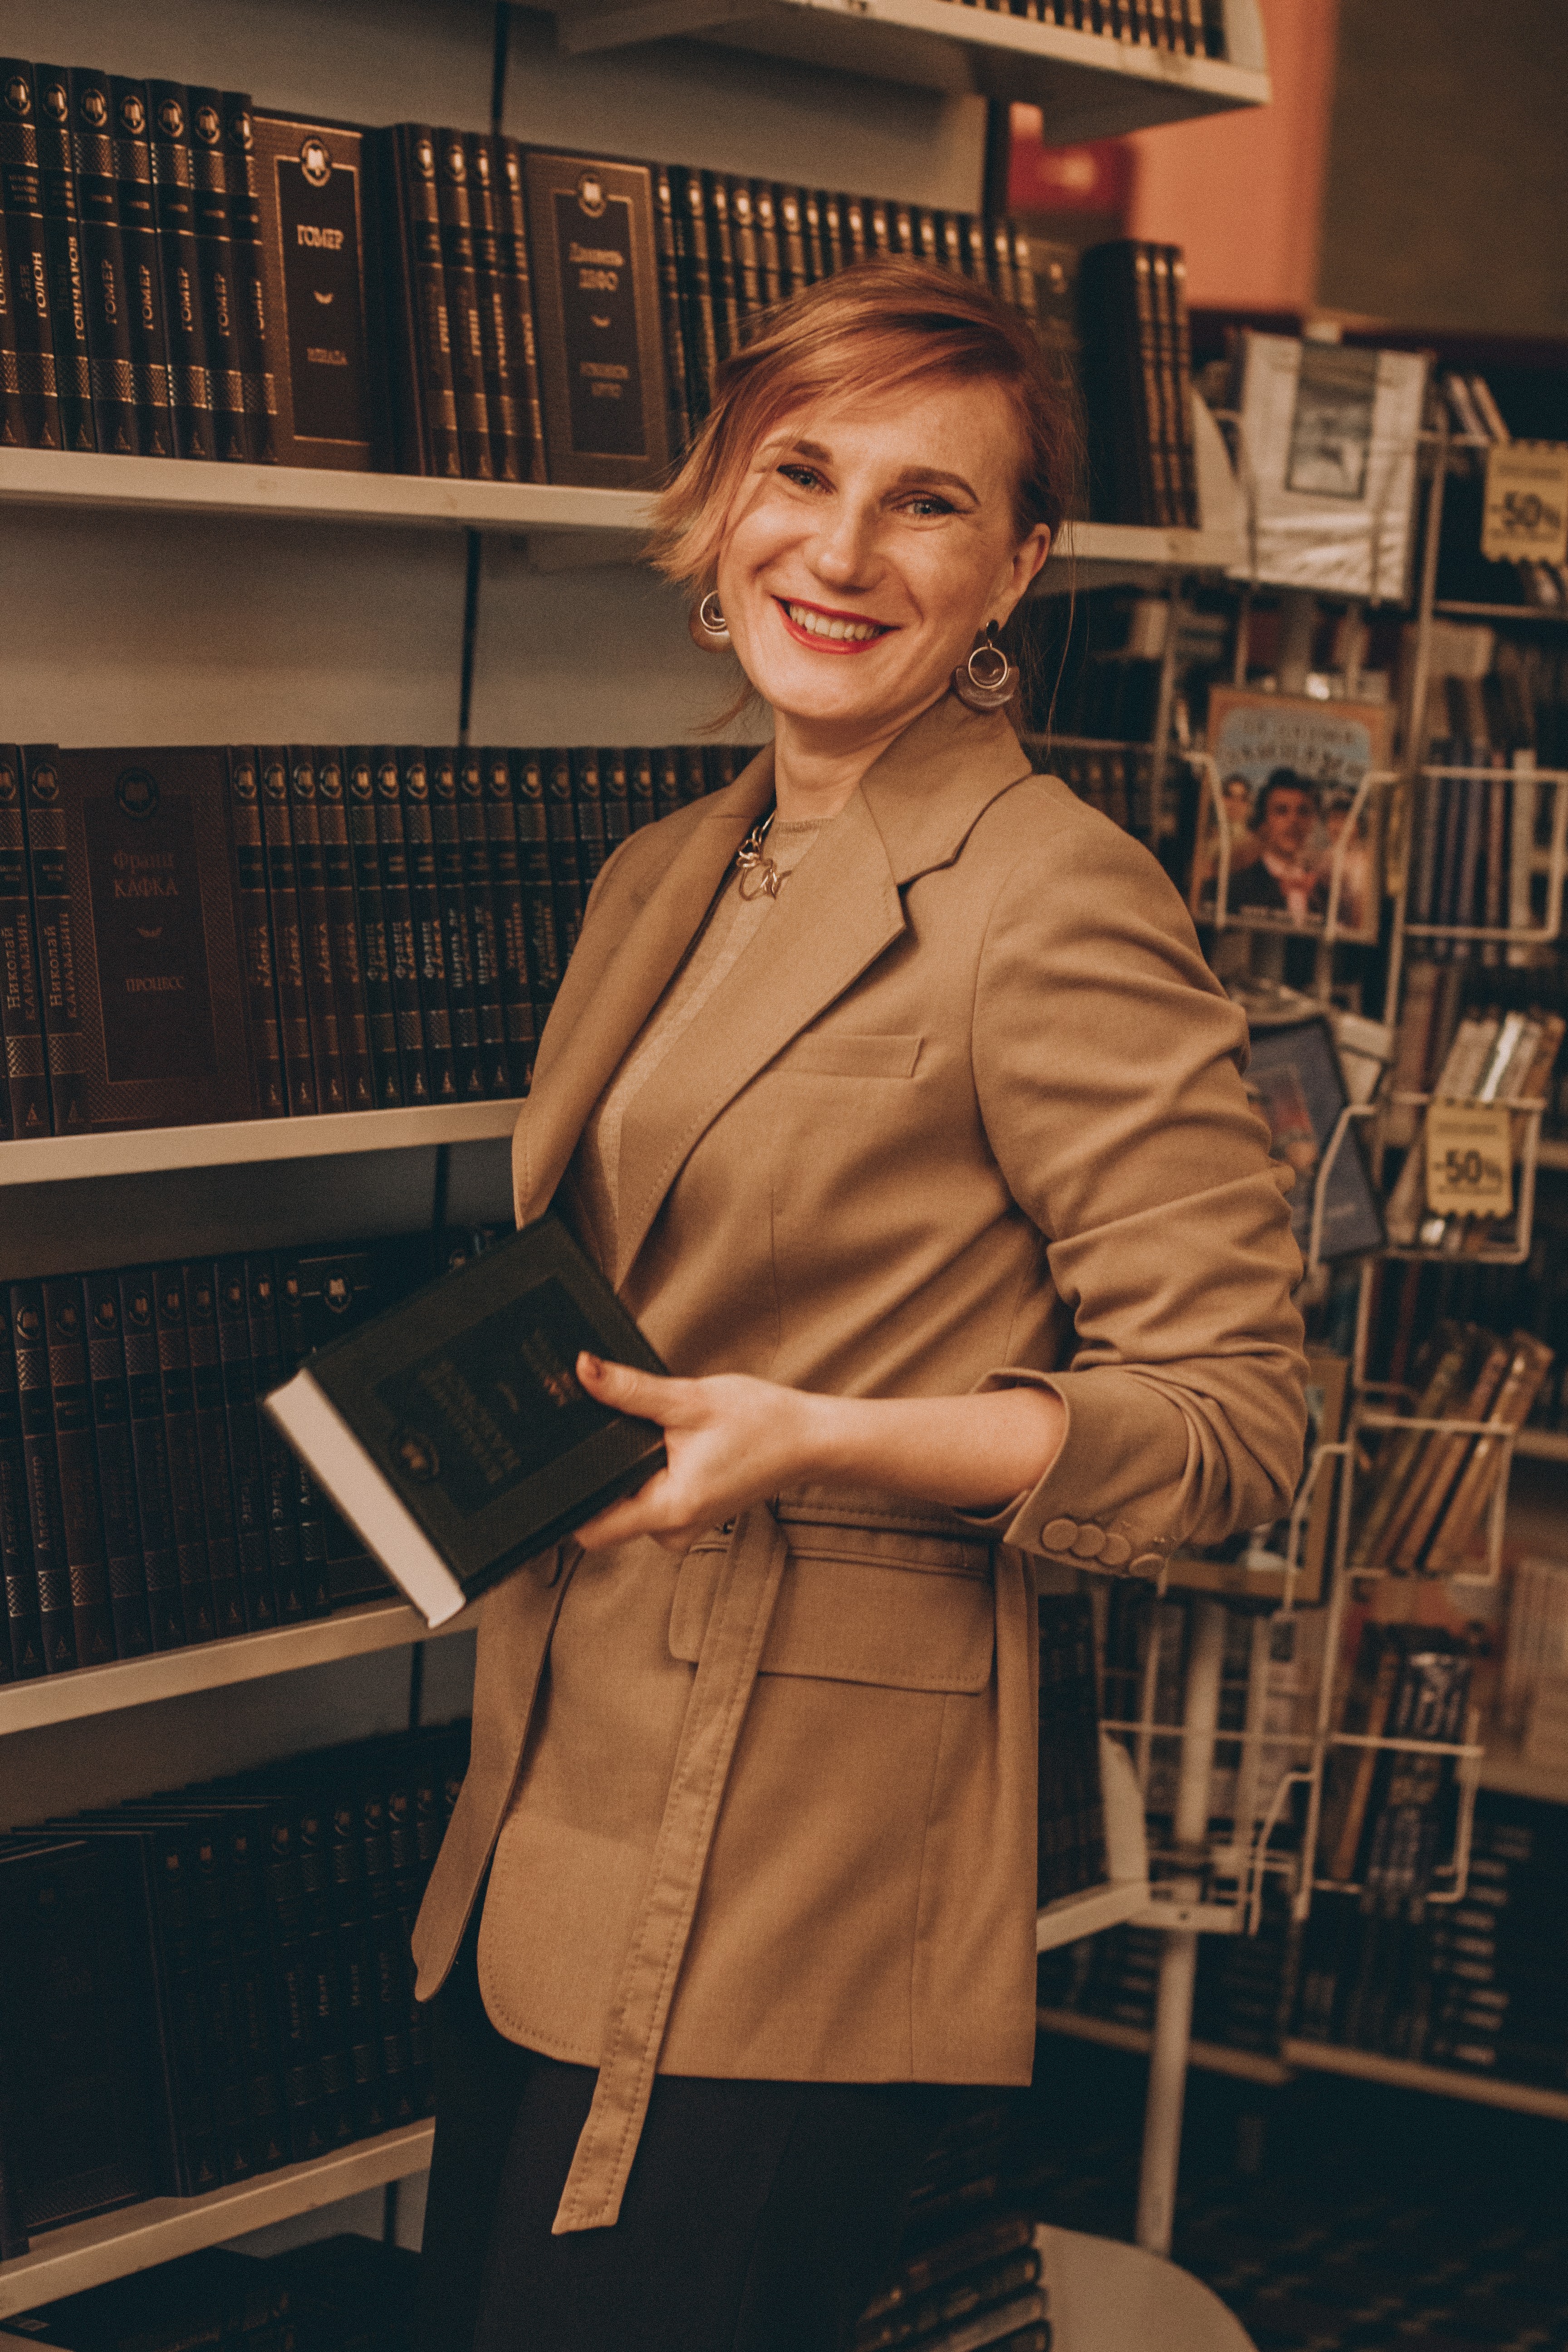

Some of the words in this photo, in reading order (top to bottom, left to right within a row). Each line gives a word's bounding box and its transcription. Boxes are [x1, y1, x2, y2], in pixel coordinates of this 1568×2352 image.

[297, 224, 343, 250] ГОМЕР
[31, 251, 47, 319] ГОЛОН
[68, 235, 86, 341] ГОНЧАРОВ
[101, 259, 118, 325] ГОМЕР
[139, 264, 154, 331] ГОМЕР
[177, 266, 193, 333] ГОМЕР
[214, 272, 230, 338] ГОМЕР
[113, 849, 175, 875] Франц
[113, 876, 179, 899] КАФКА
[1, 926, 21, 1010] Николай
[16, 913, 35, 1020] КАРАМЗИН
[44, 926, 63, 1007] Николай
[59, 912, 77, 1018] КАРАМЗИН
[258, 923, 272, 988] КАФКА
[289, 923, 303, 987] КАФКА
[319, 922, 332, 984] КАФКА
[347, 921, 359, 983] КАФКА
[377, 920, 388, 982] КАФКА
[404, 920, 417, 980] КАФКА
[433, 919, 445, 979] КАФКА
[125, 975, 186, 994] ПРОЦЕСС
